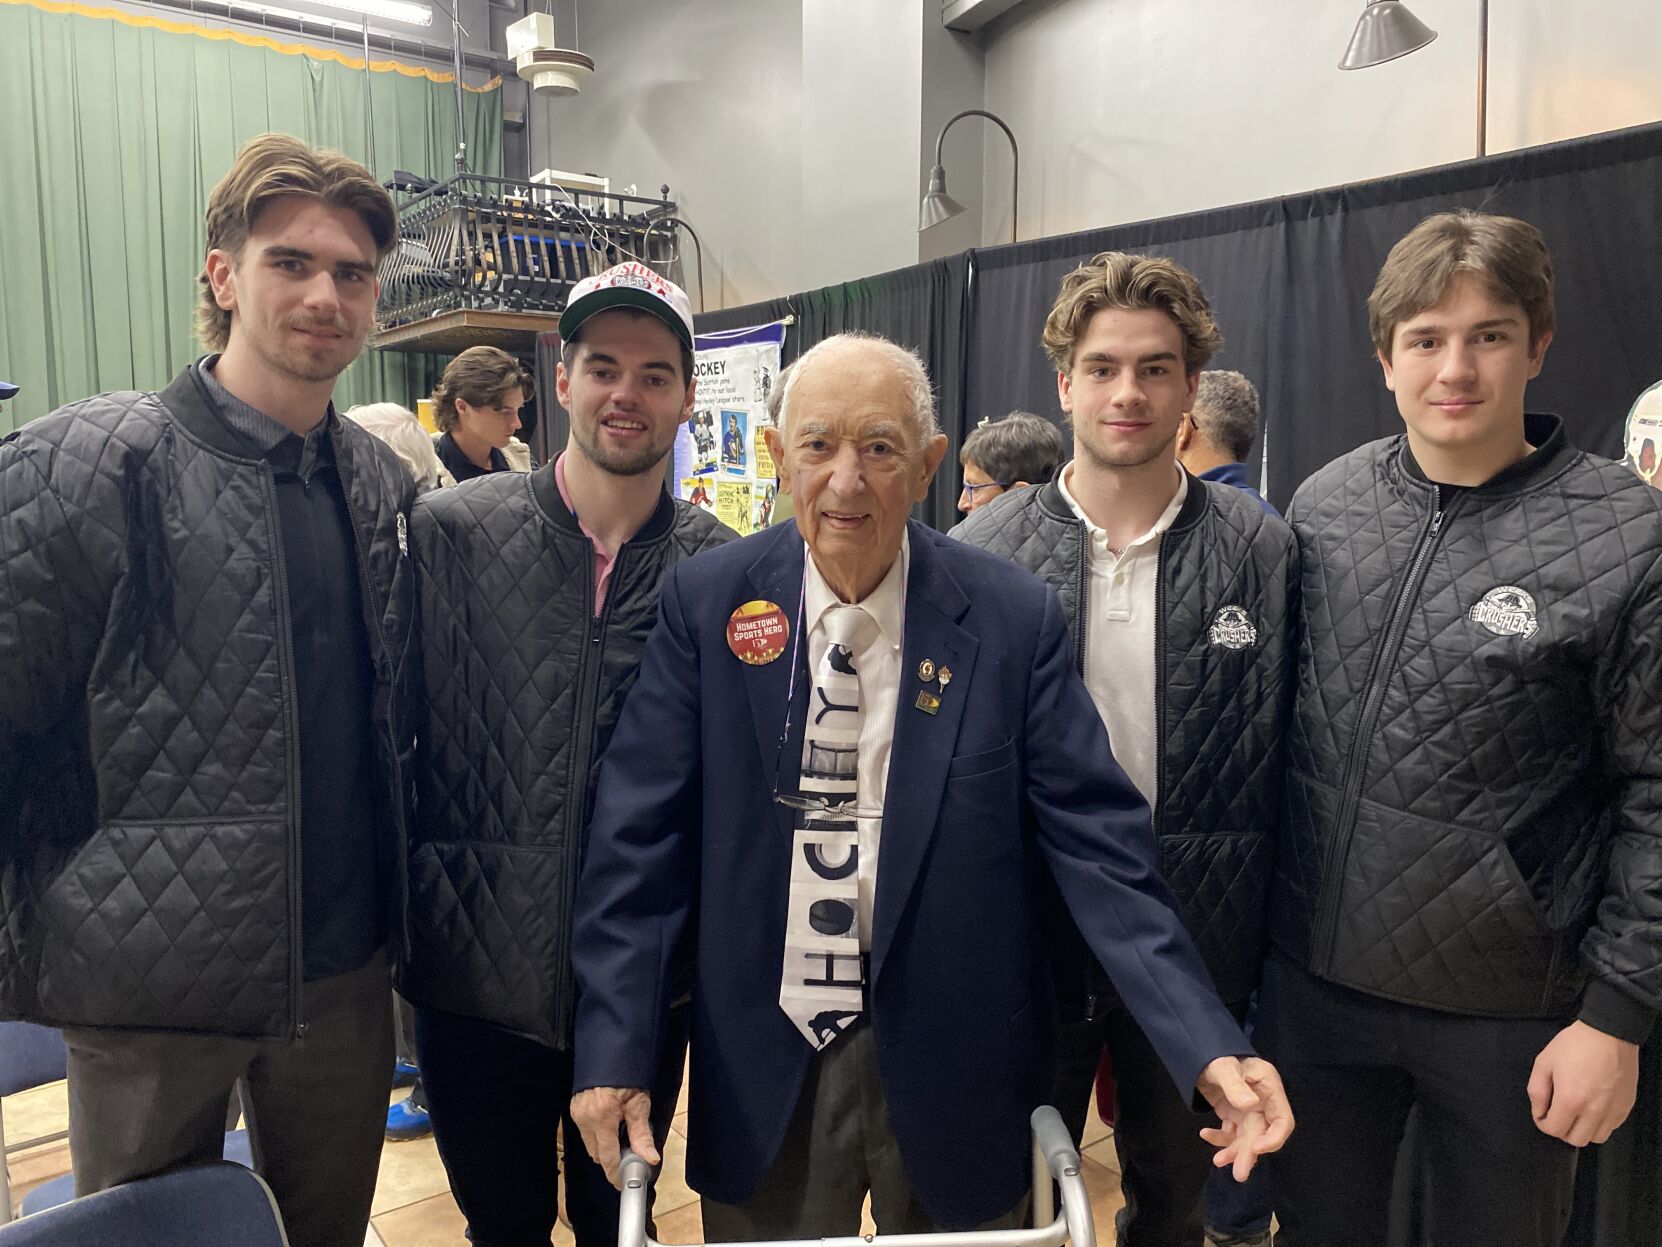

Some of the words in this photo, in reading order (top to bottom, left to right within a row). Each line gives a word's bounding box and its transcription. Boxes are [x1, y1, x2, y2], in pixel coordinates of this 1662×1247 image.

[694, 360, 726, 377] OCKEY
[736, 617, 778, 632] HOMETOWN
[1477, 603, 1537, 638] CRUSHERS
[734, 629, 763, 641] SPORTS
[764, 625, 783, 636] HERO
[1213, 626, 1257, 645] CRUSHERS
